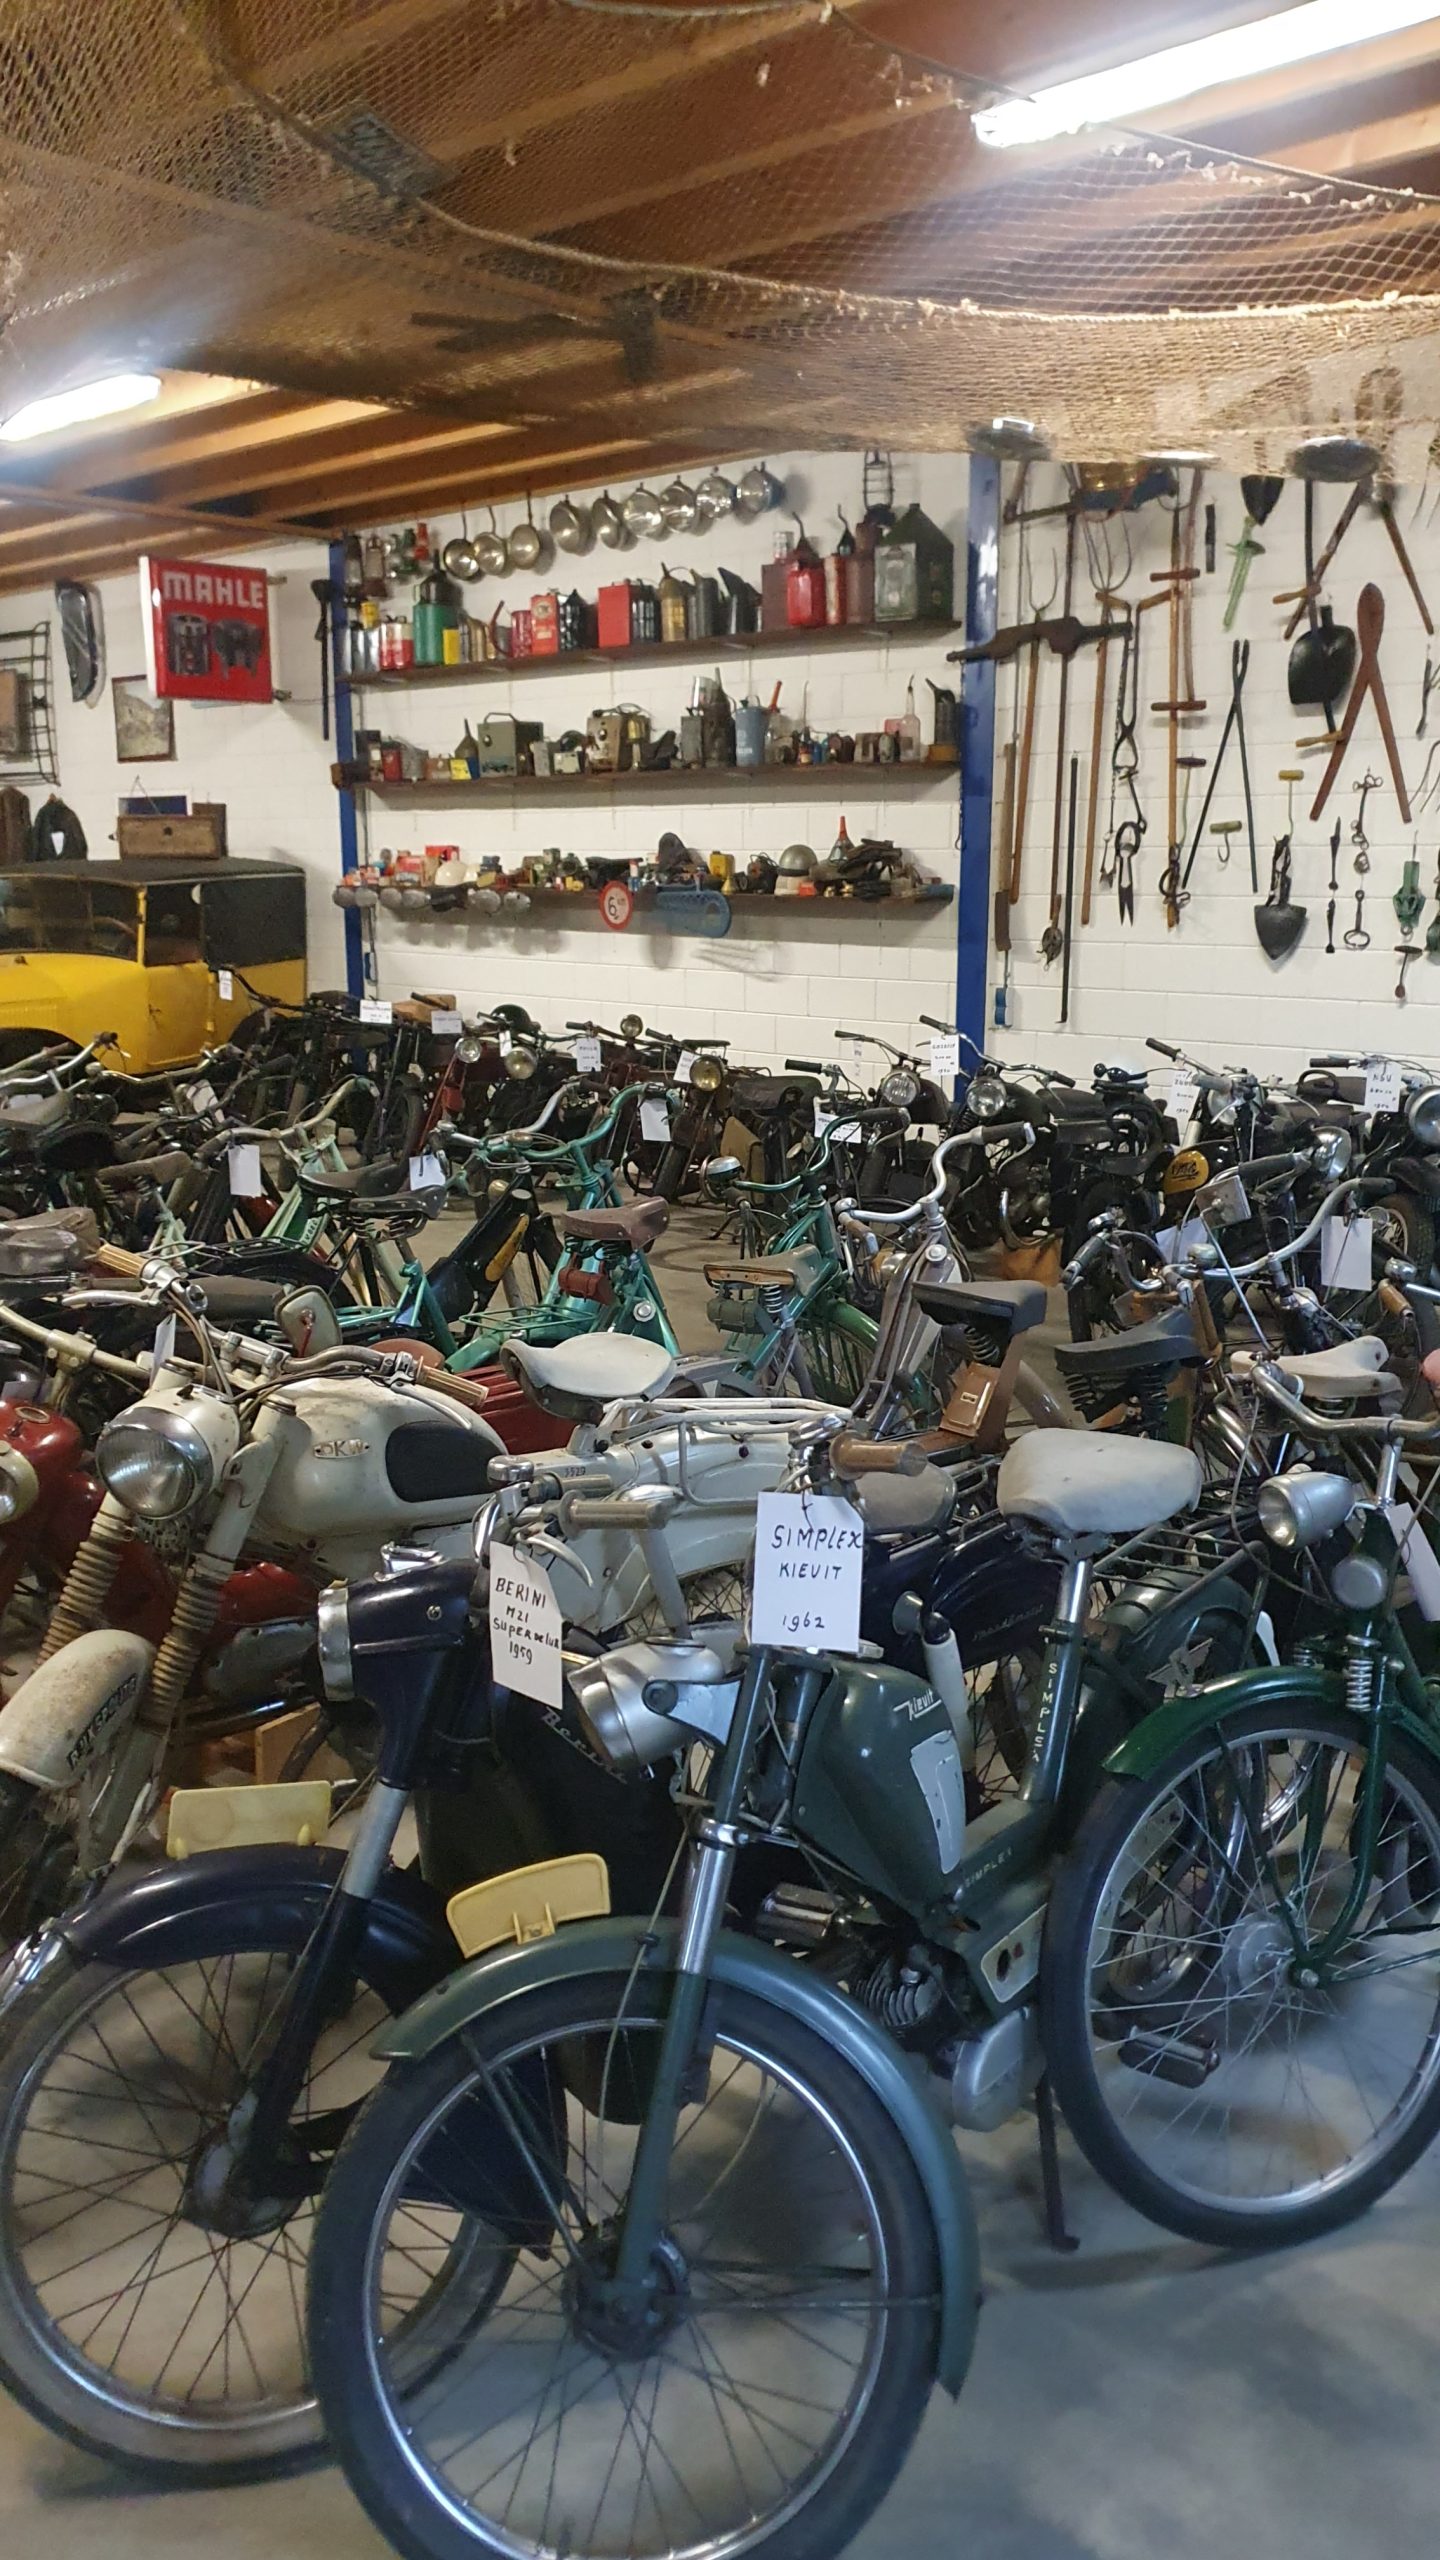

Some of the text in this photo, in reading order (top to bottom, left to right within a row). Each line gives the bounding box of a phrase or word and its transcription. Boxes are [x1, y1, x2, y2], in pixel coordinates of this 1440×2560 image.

[162, 571, 264, 609] MAHLE
[320, 1440, 363, 1457] DKW
[771, 1524, 863, 1551] SIMPLEX
[495, 1577, 546, 1608] BERINI
[506, 1605, 529, 1624] M21
[782, 1611, 825, 1632] 1962
[508, 1640, 533, 1665] 1959
[1031, 1662, 1059, 1763] SIMPLEX
